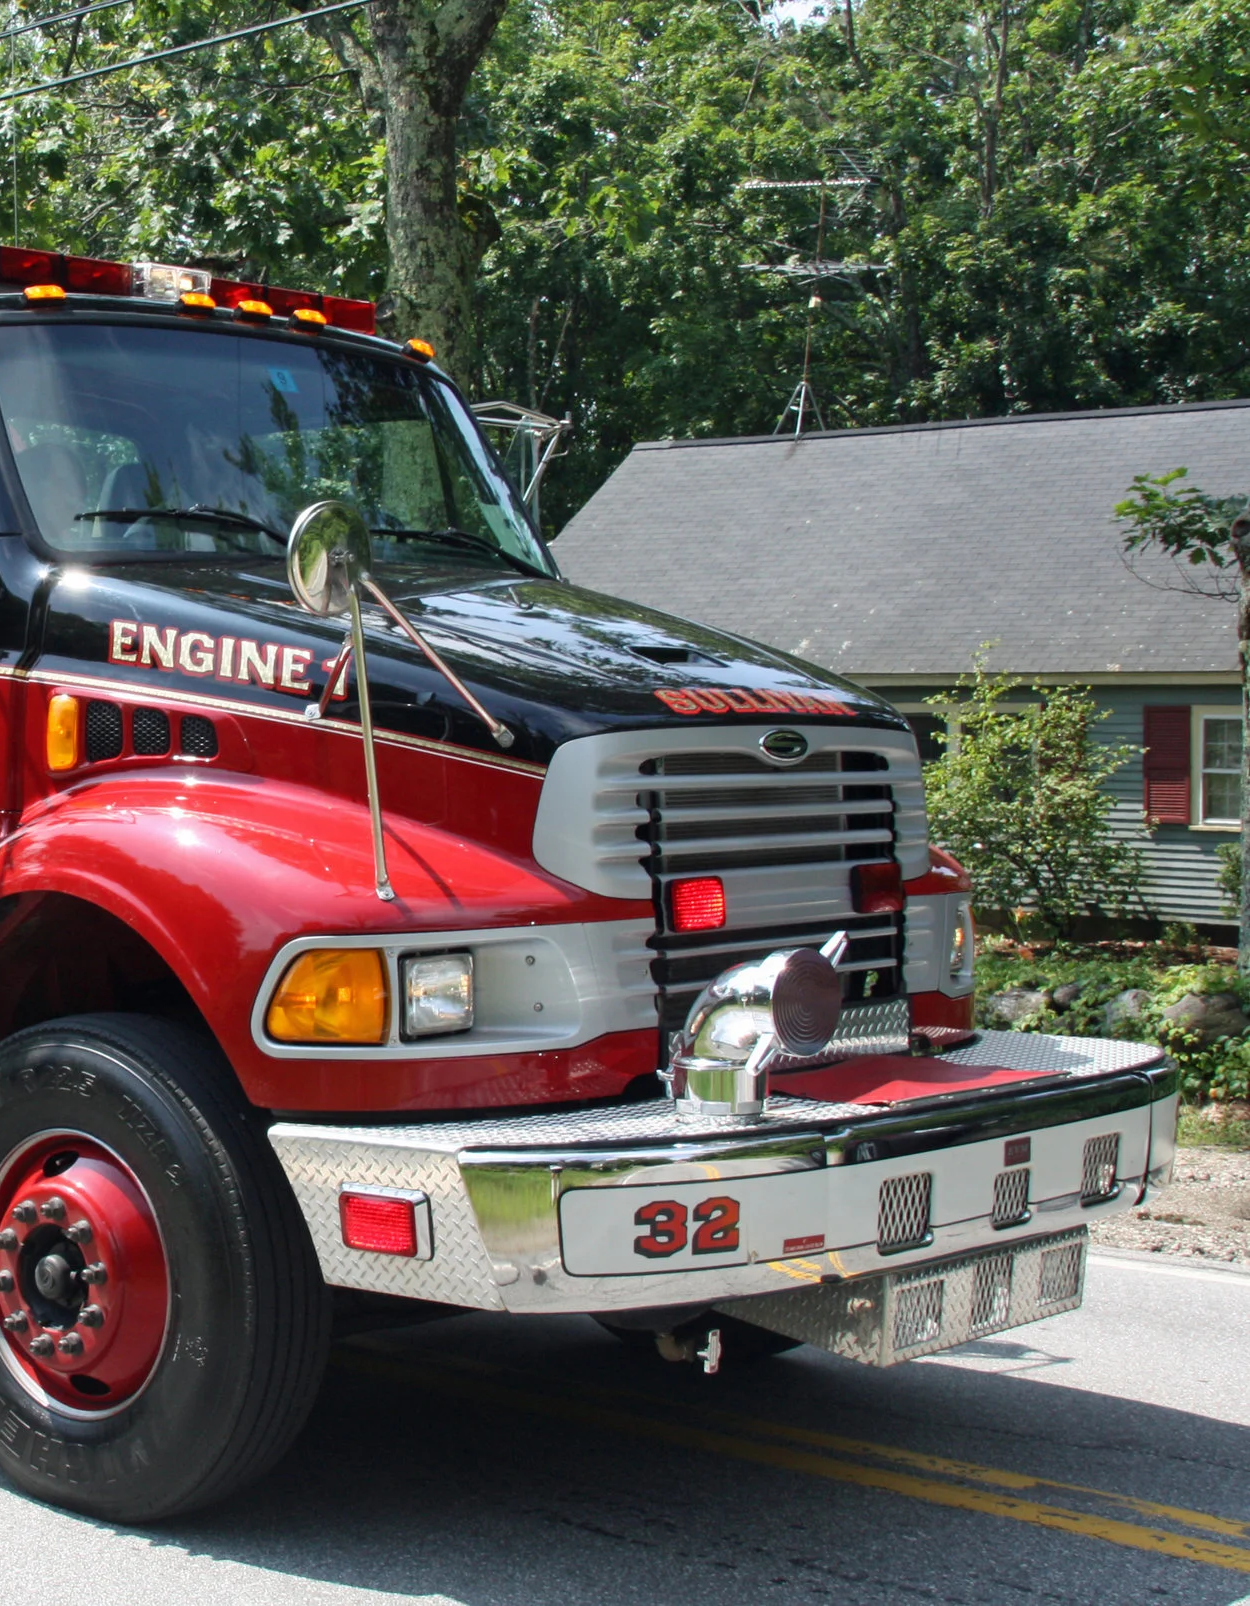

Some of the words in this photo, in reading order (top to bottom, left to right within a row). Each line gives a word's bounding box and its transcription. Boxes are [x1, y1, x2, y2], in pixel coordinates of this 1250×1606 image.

[109, 618, 314, 694] ENGINE
[654, 688, 856, 717] SULLIVAN
[634, 1195, 740, 1258] 32
